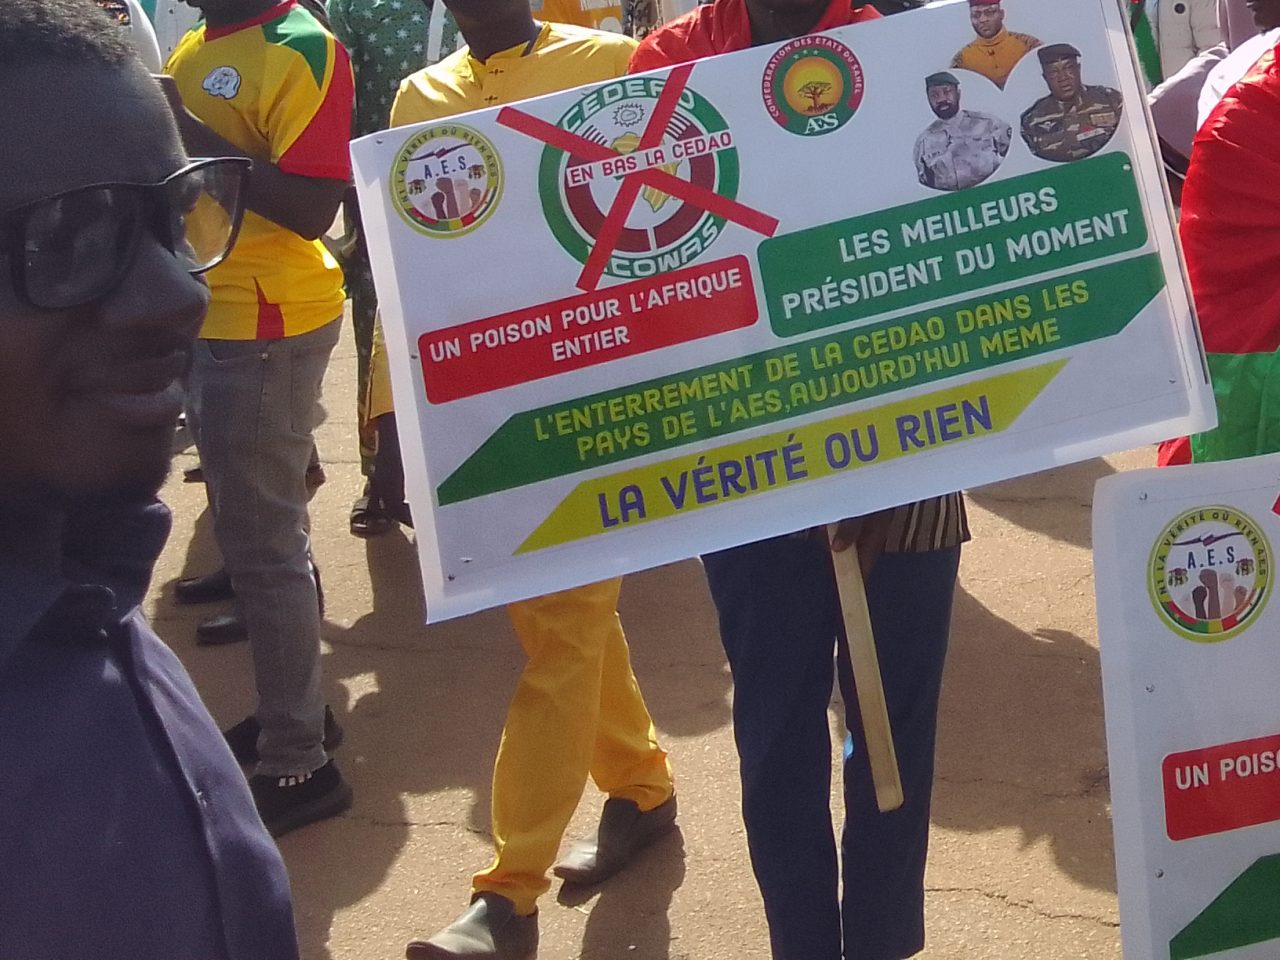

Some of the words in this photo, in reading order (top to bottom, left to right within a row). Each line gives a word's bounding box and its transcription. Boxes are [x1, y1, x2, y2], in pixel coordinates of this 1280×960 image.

[763, 44, 792, 117] CONFEDERATION
[793, 37, 812, 48] DES
[815, 37, 843, 52] ETATS
[843, 50, 855, 63] DU
[851, 64, 863, 94] SAHEL
[804, 112, 839, 134] AES
[424, 155, 467, 180] A.E.S
[570, 165, 593, 185] EN
[602, 156, 638, 177] BAS
[645, 150, 665, 167] LA
[672, 131, 732, 159] CEDAO
[597, 216, 720, 277] COWAS
[838, 228, 890, 264] LES
[900, 186, 1059, 245] MEILLEURS
[781, 255, 944, 321] PRÉSIDENT
[957, 243, 996, 277] DU
[1005, 208, 1130, 264] MOMENT
[430, 340, 461, 363] UN
[470, 313, 552, 354] POISON
[561, 297, 621, 328] POUR
[629, 268, 743, 314] L'AFRIQUE
[551, 326, 631, 363] ENTIER
[534, 362, 756, 440] L'ENTERREMENT
[764, 351, 802, 383] DE
[812, 341, 845, 372] LA
[854, 316, 947, 360] CEDAO
[955, 289, 1035, 335] DANS
[1042, 279, 1090, 311] LES
[577, 424, 652, 462] PAYS
[667, 407, 699, 439] DE
[980, 318, 1062, 360] MEME
[598, 483, 646, 529] LA
[660, 433, 810, 509] VÉRITÉ
[827, 423, 882, 472] OU
[900, 394, 994, 453] RIEN
[1187, 546, 1235, 569] A.E.S
[1174, 763, 1210, 792] UN
